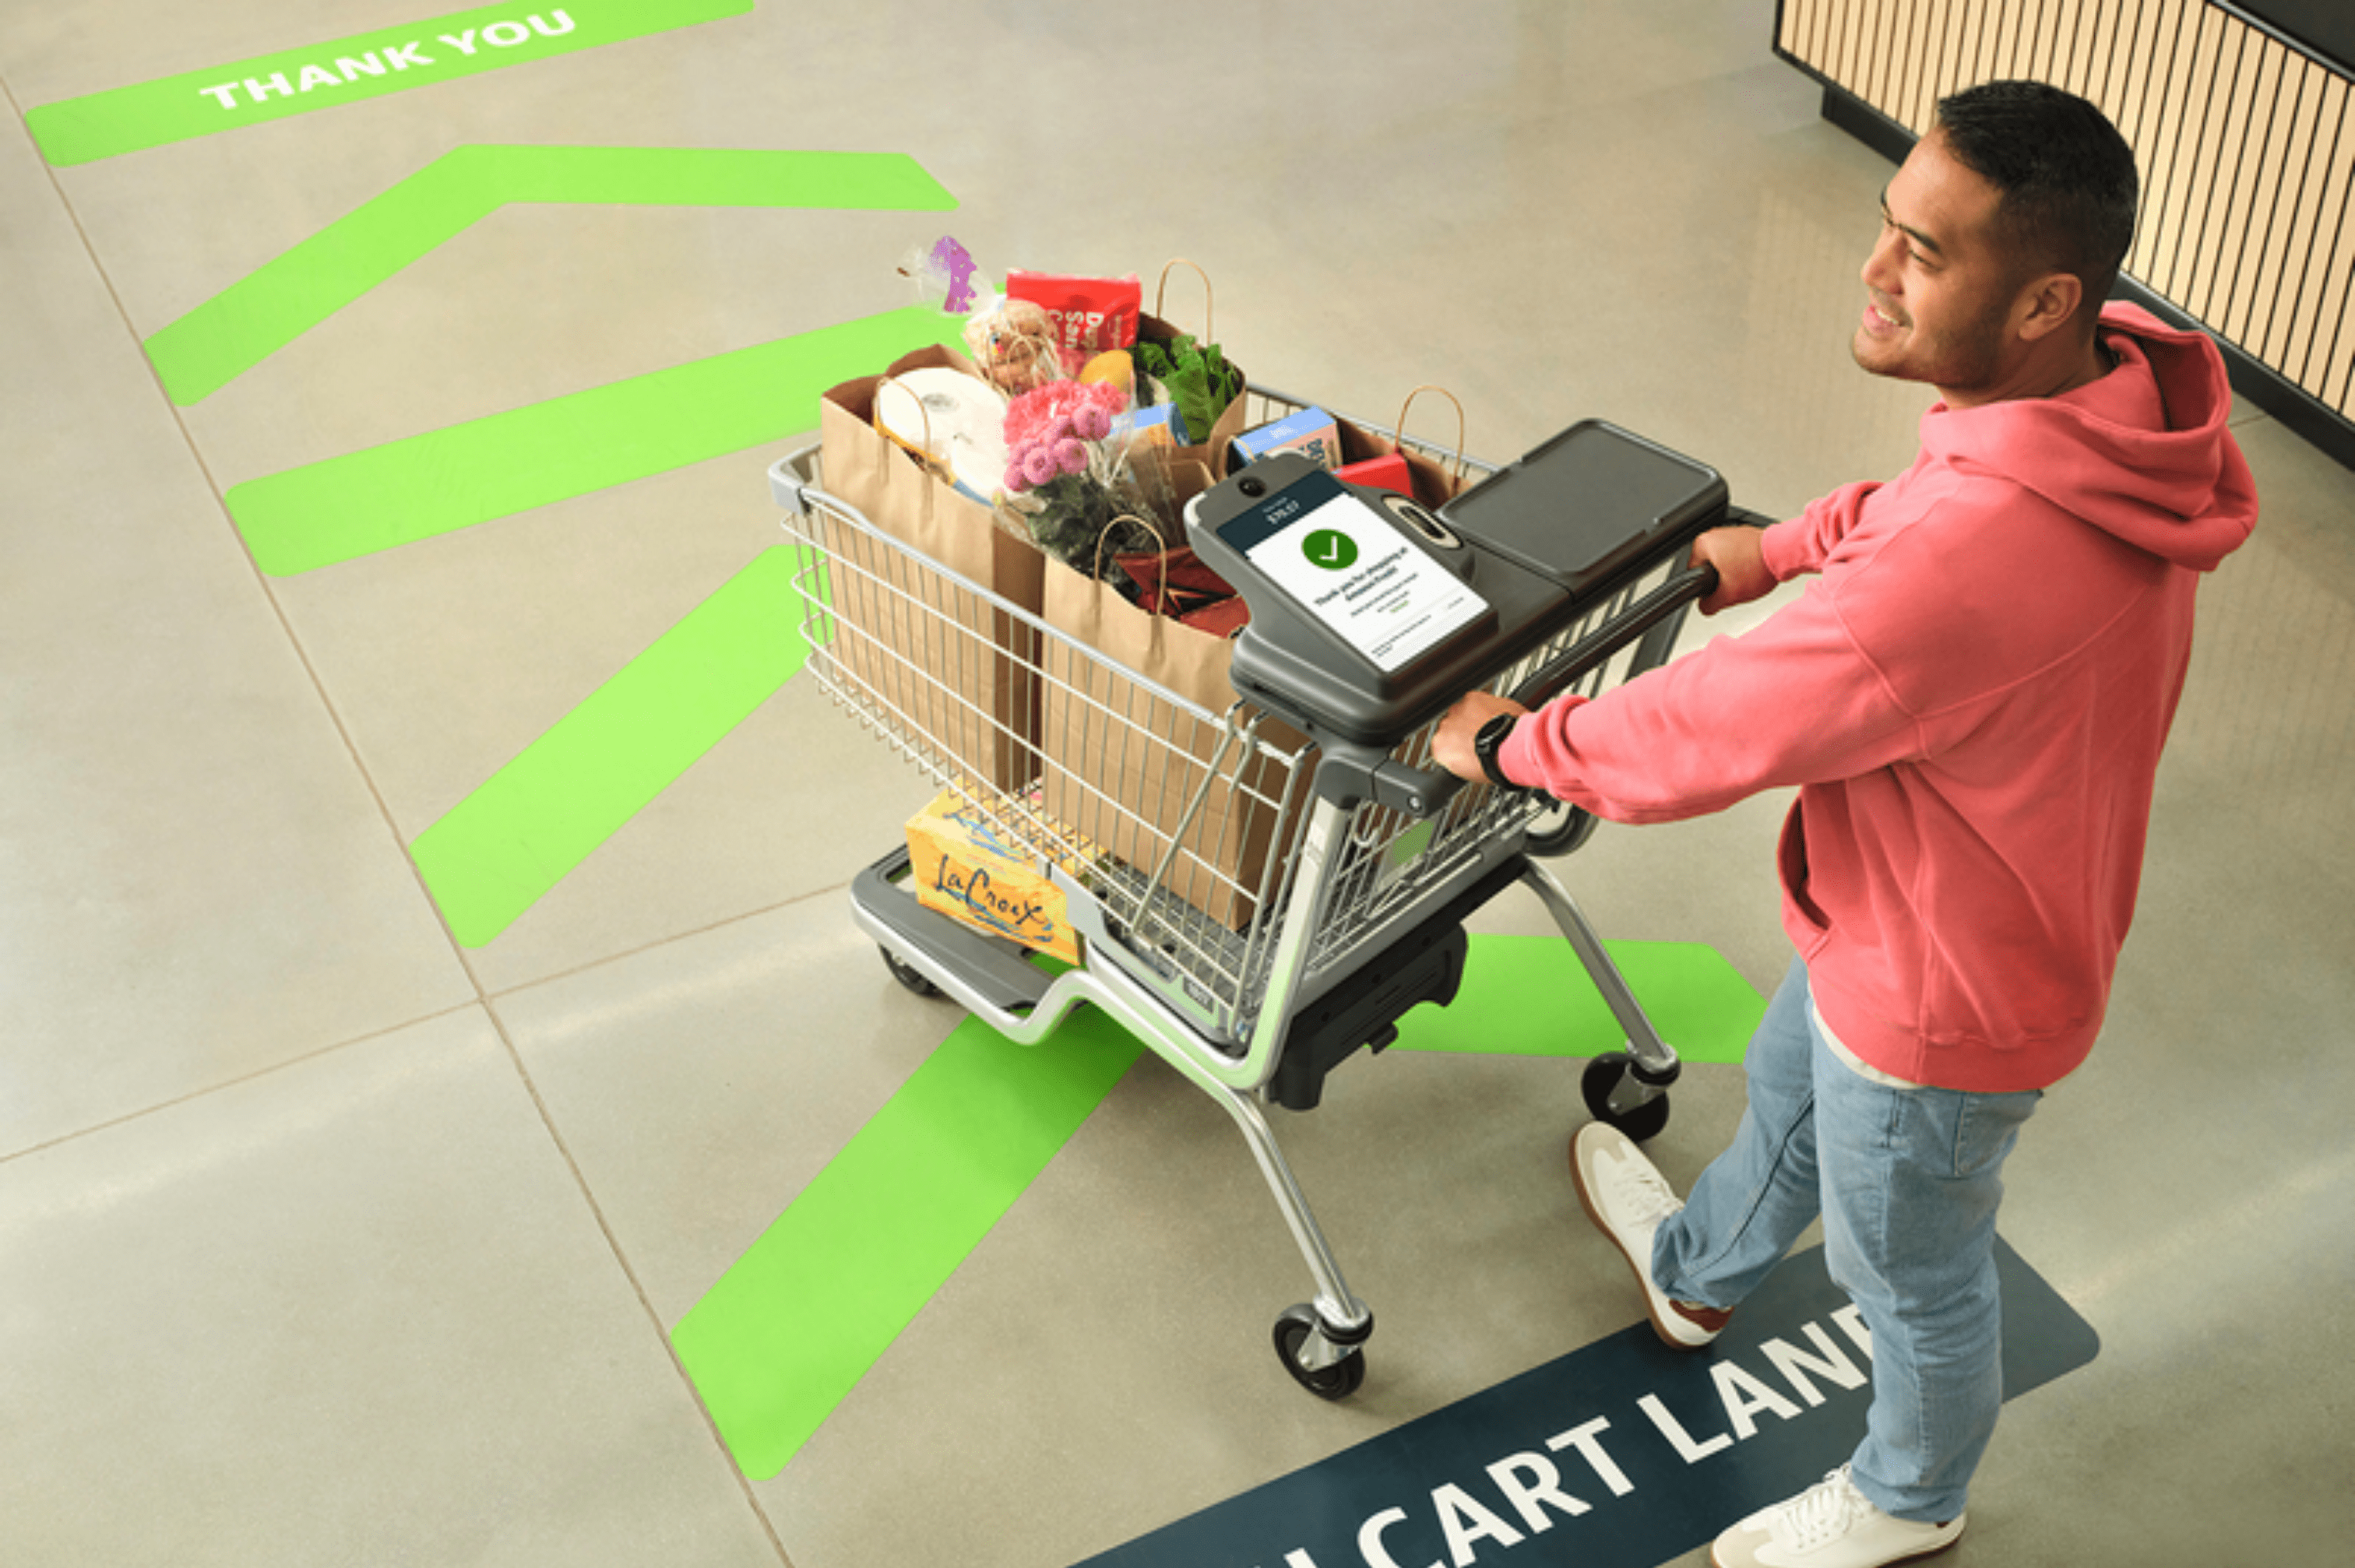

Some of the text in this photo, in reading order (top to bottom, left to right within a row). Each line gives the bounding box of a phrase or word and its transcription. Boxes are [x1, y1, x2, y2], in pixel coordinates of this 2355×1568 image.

[199, 8, 576, 110] THANK YOU
[1064, 310, 1085, 348] San
[1357, 1415, 1636, 1568] CART
